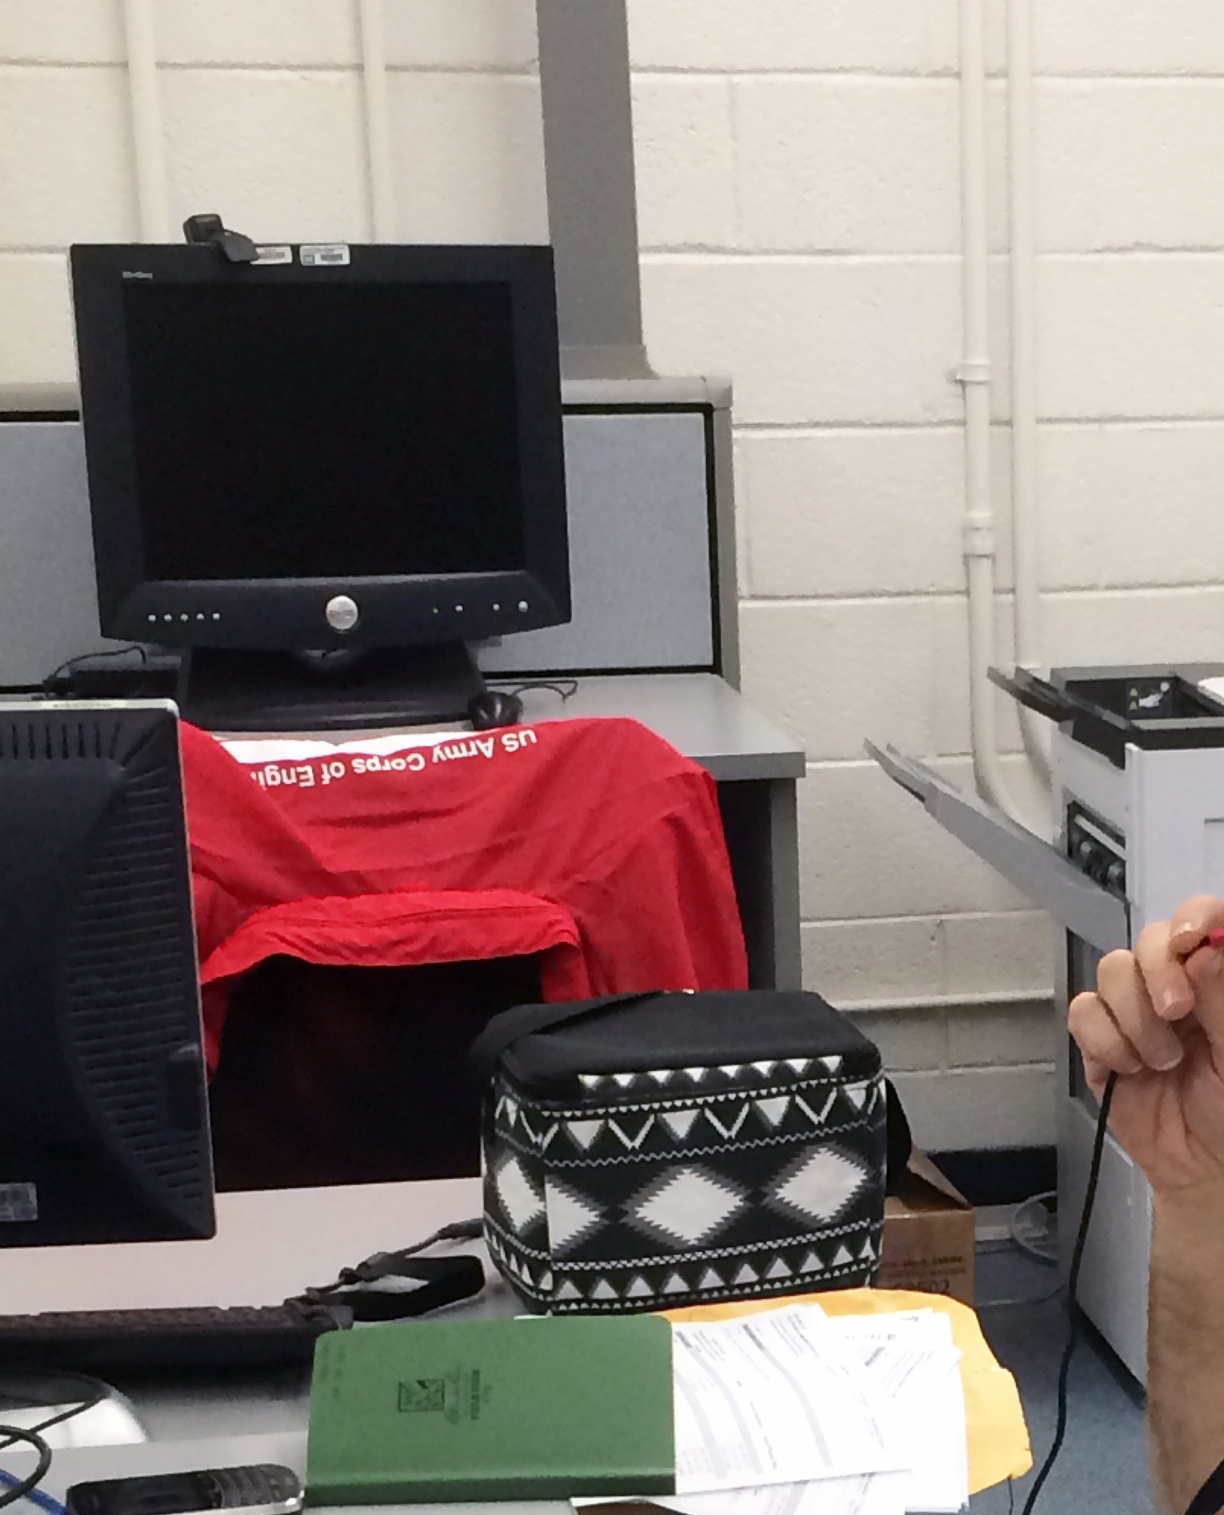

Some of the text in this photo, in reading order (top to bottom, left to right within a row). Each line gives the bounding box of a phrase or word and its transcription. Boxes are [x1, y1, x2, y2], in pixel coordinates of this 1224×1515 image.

[251, 729, 537, 790] US Army Corps of Engi
